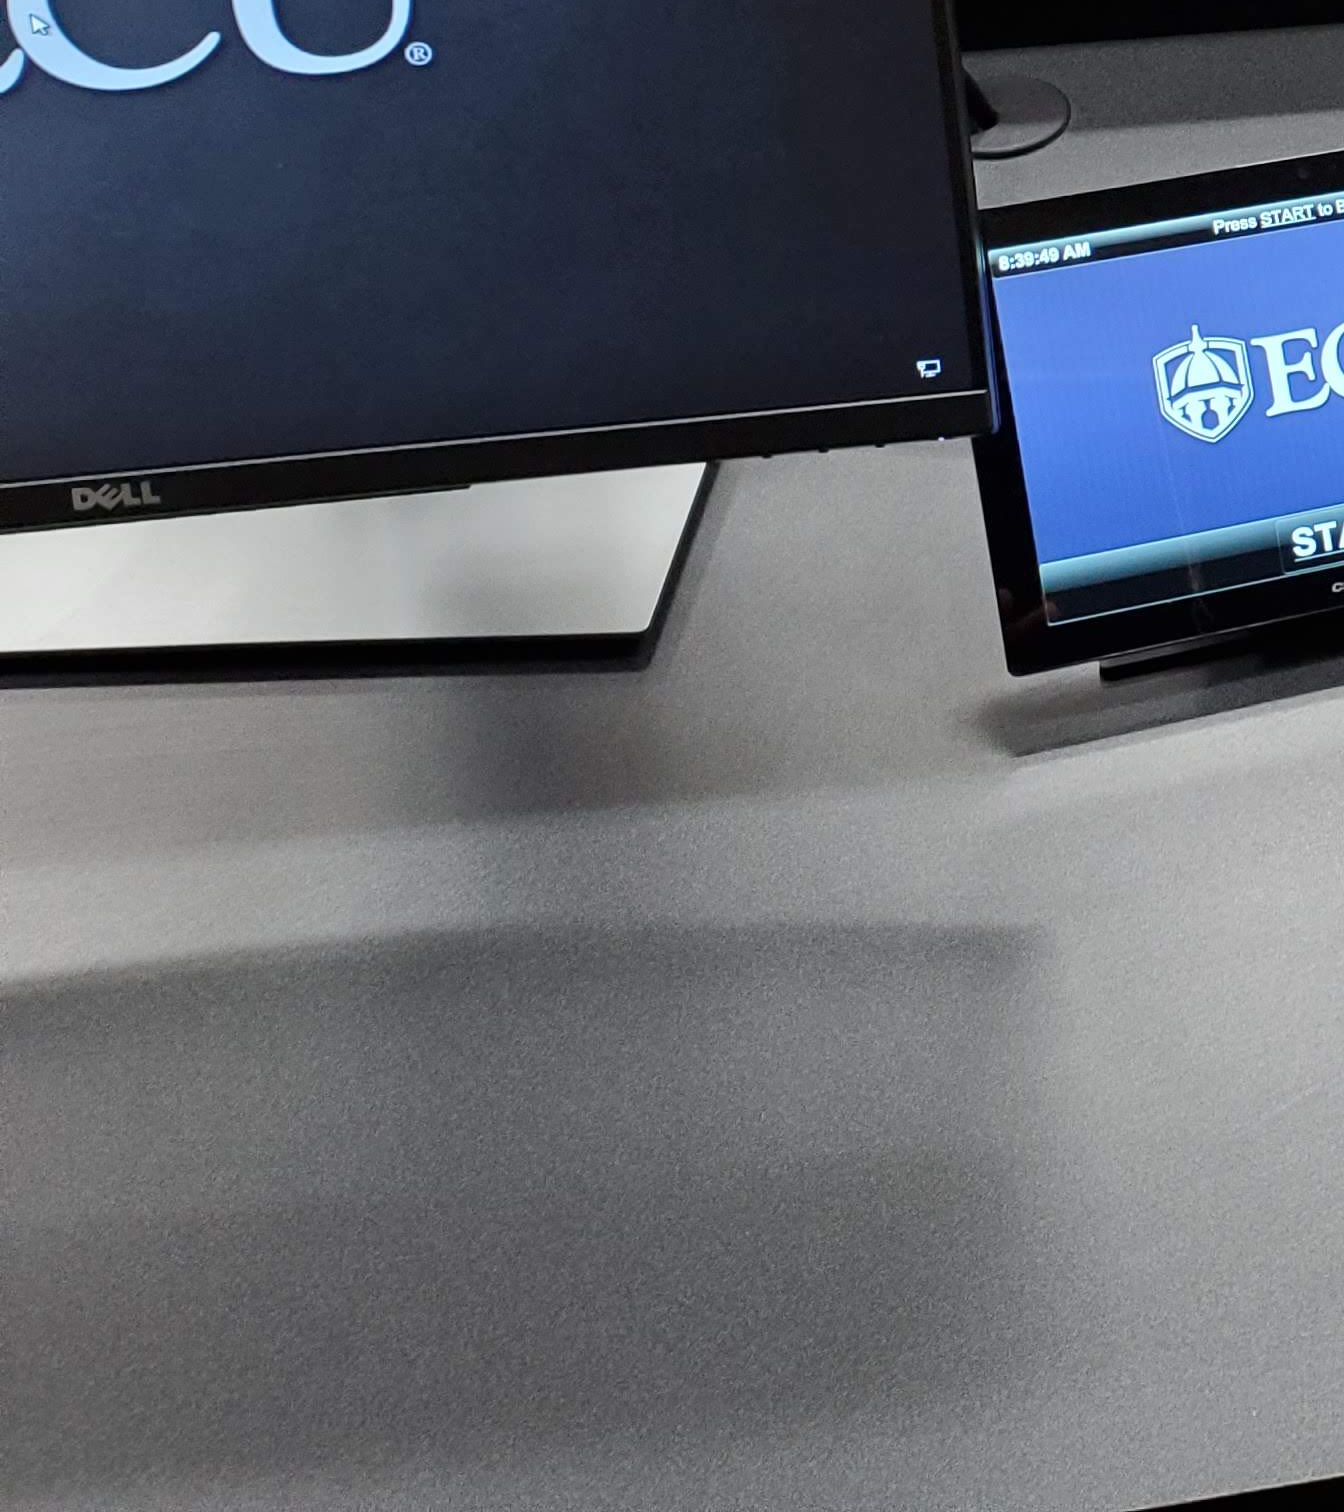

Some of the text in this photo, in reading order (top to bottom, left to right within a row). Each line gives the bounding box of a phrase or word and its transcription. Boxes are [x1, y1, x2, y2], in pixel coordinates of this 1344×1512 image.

[1213, 216, 1257, 235] Press
[1261, 205, 1315, 228] START
[1318, 202, 1333, 216] to
[1063, 241, 1091, 261] AM
[71, 480, 161, 511] DELL
